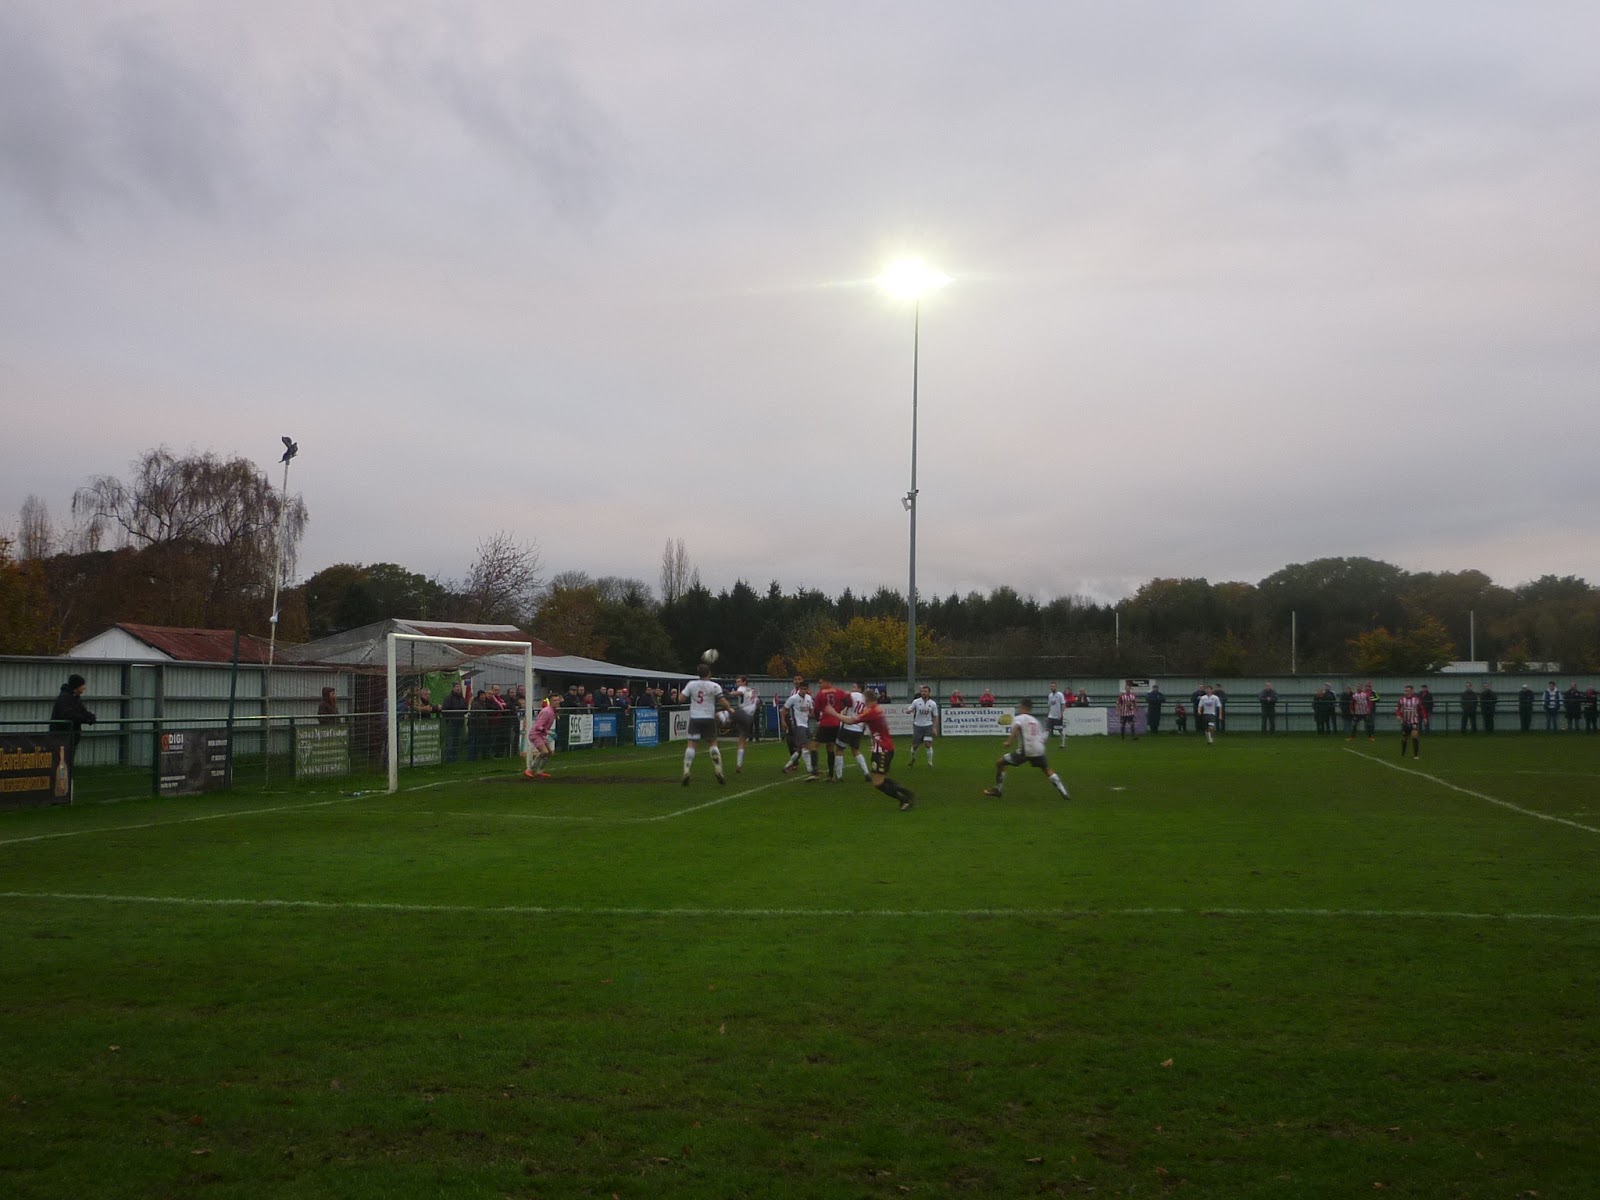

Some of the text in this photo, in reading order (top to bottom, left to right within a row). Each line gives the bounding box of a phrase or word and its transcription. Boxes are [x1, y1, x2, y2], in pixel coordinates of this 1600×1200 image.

[696, 690, 704, 704] 5
[854, 700, 865, 713] 10
[168, 733, 184, 744] DIGI
